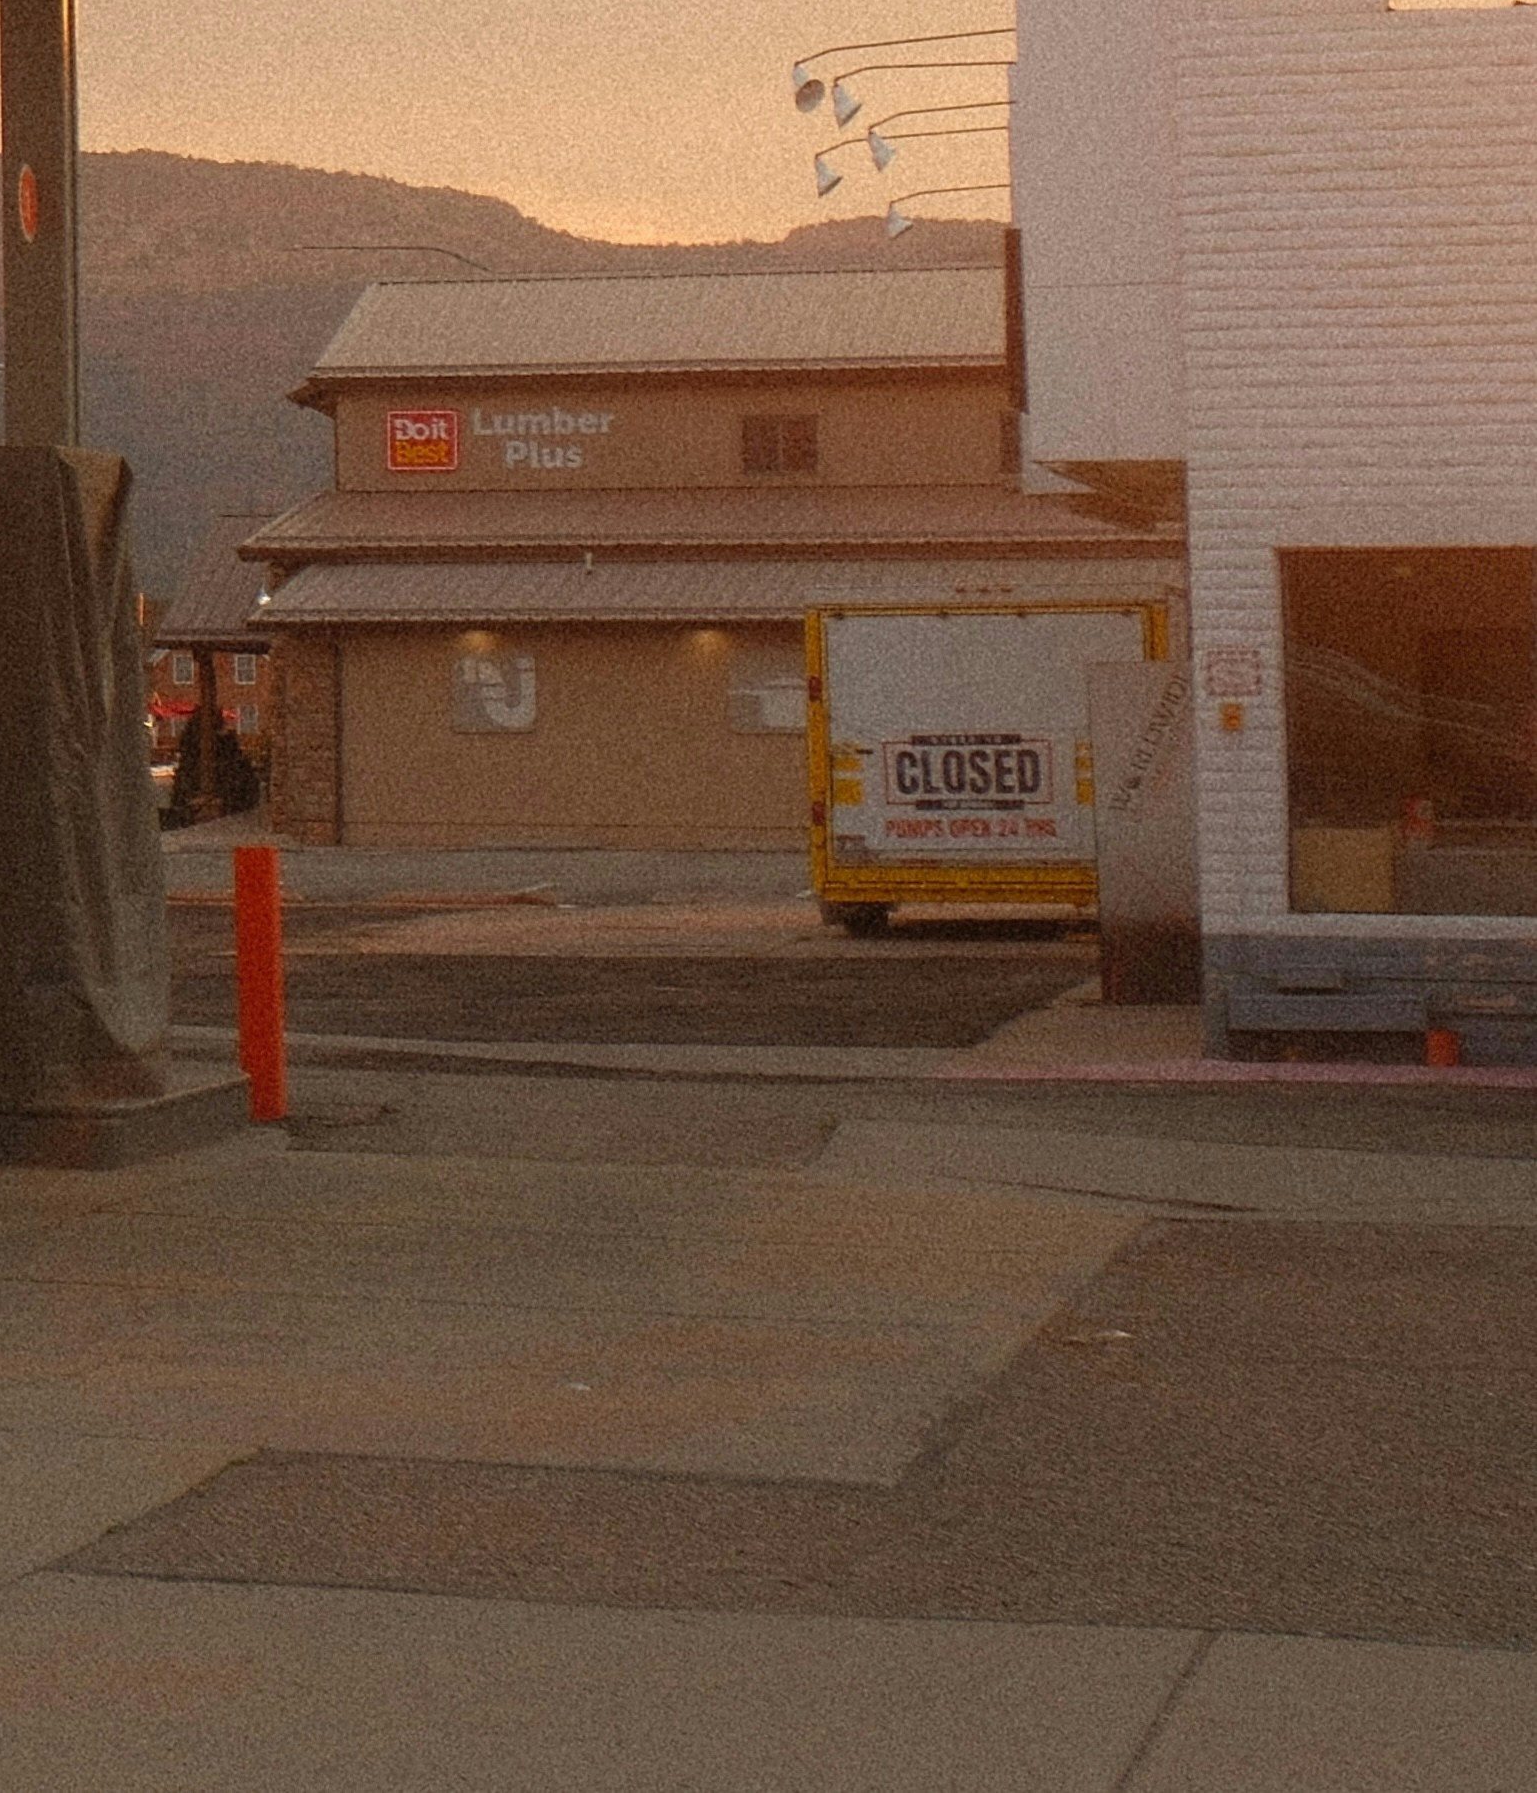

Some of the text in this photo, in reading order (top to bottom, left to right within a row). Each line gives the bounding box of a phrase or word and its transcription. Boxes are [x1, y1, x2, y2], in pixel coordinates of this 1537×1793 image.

[473, 406, 614, 436] Lumber
[395, 442, 450, 464] Best
[504, 441, 584, 469] Plus
[895, 749, 1041, 795] CLOSED
[949, 819, 991, 838] OPEN
